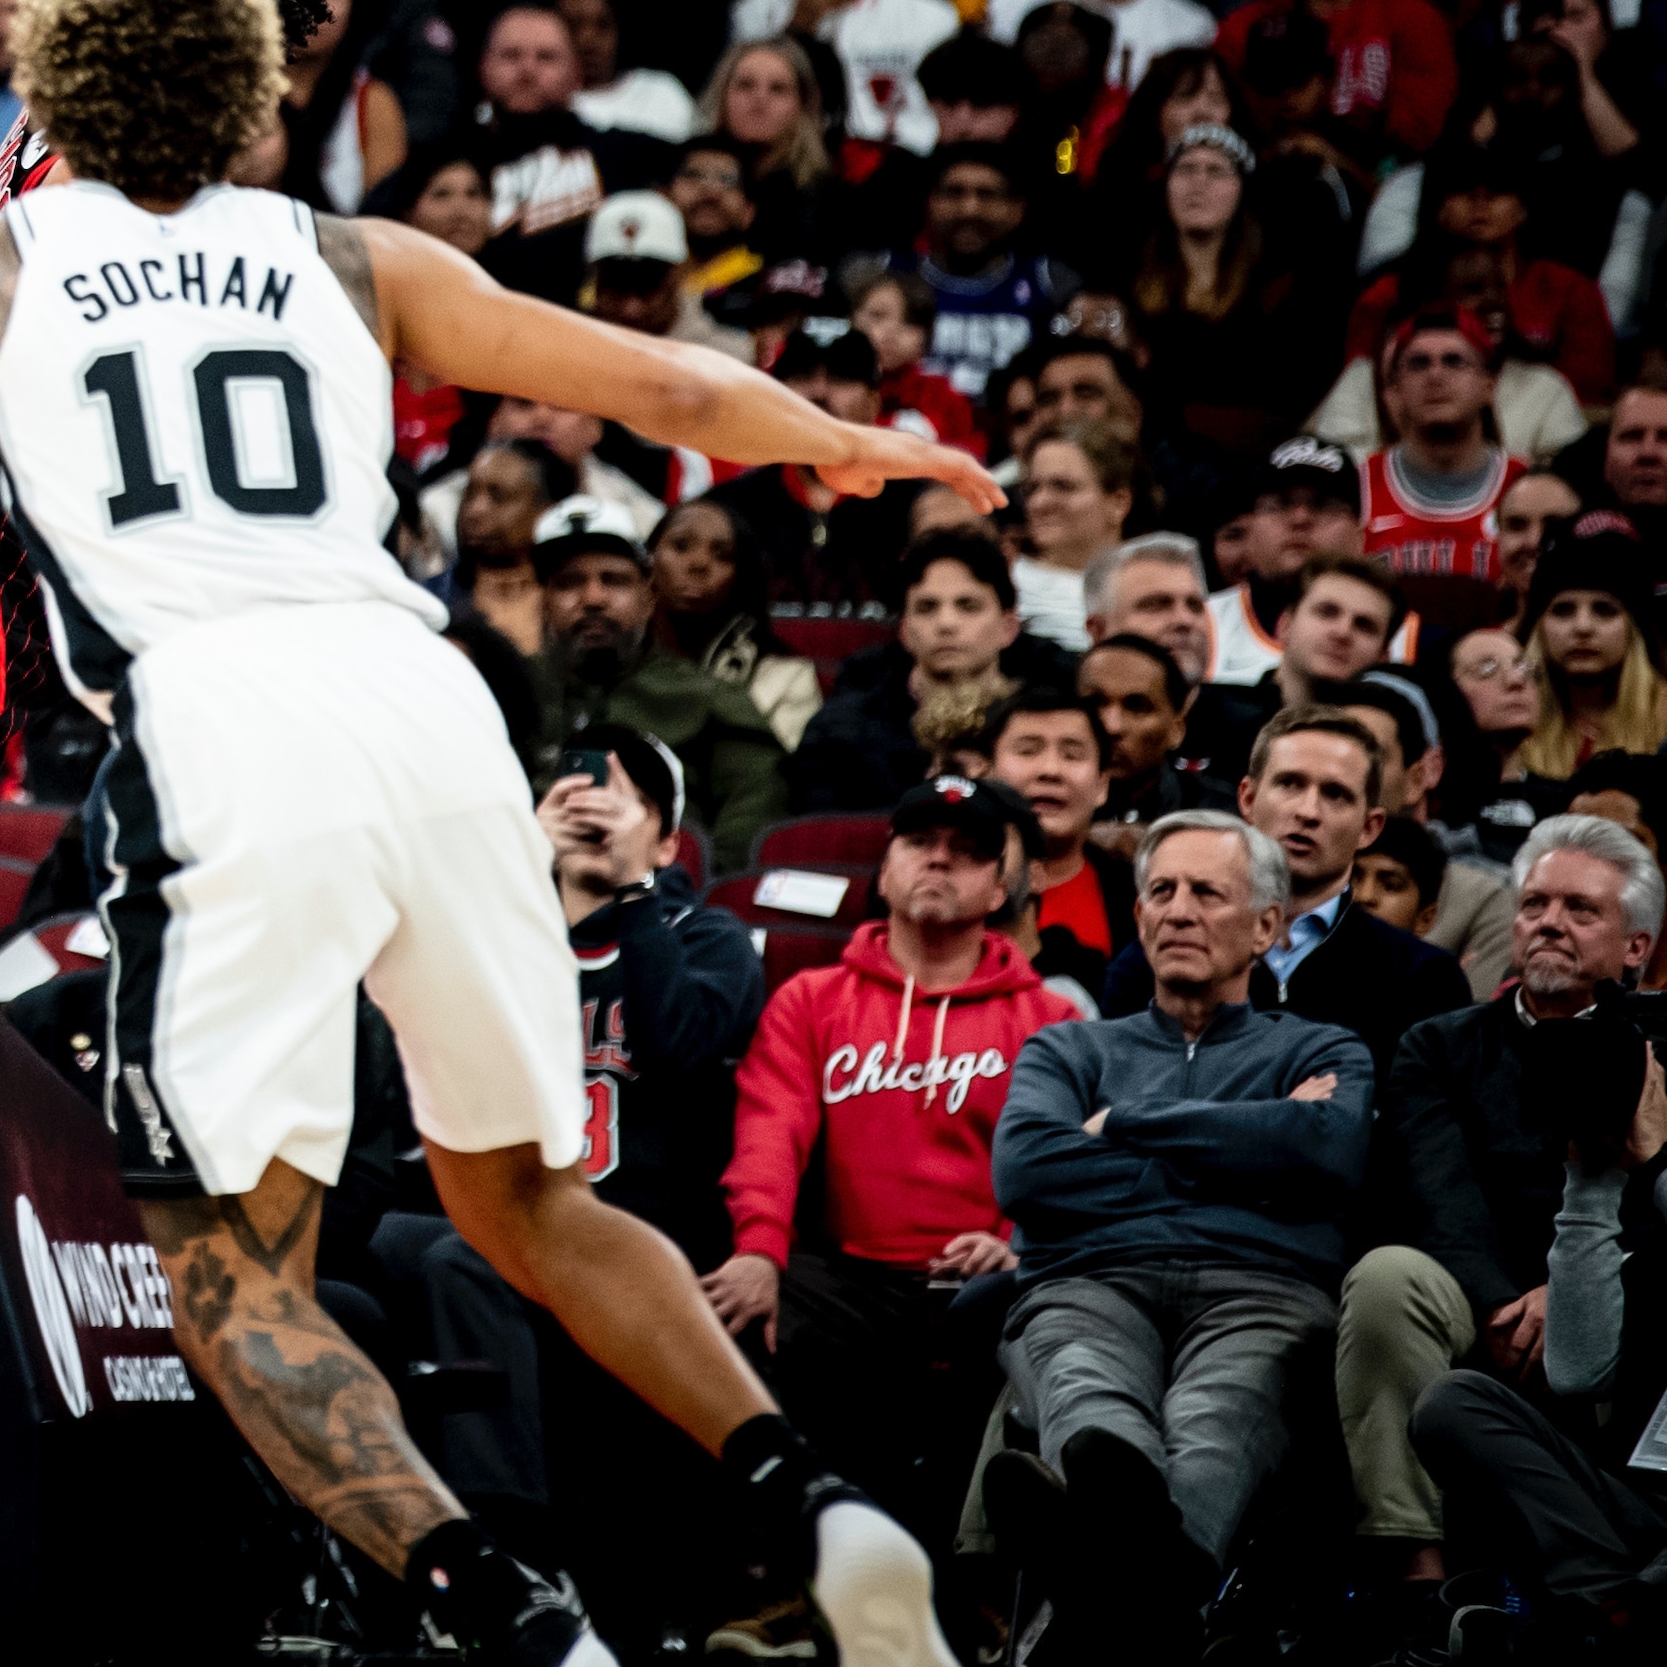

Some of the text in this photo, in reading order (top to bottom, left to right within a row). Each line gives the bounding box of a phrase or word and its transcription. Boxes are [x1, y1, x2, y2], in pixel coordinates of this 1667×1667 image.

[62, 251, 295, 322] SOCHAN
[75, 340, 338, 538] 10
[822, 1040, 1009, 1116] Chicago
[109, 1239, 176, 1330] CREE
